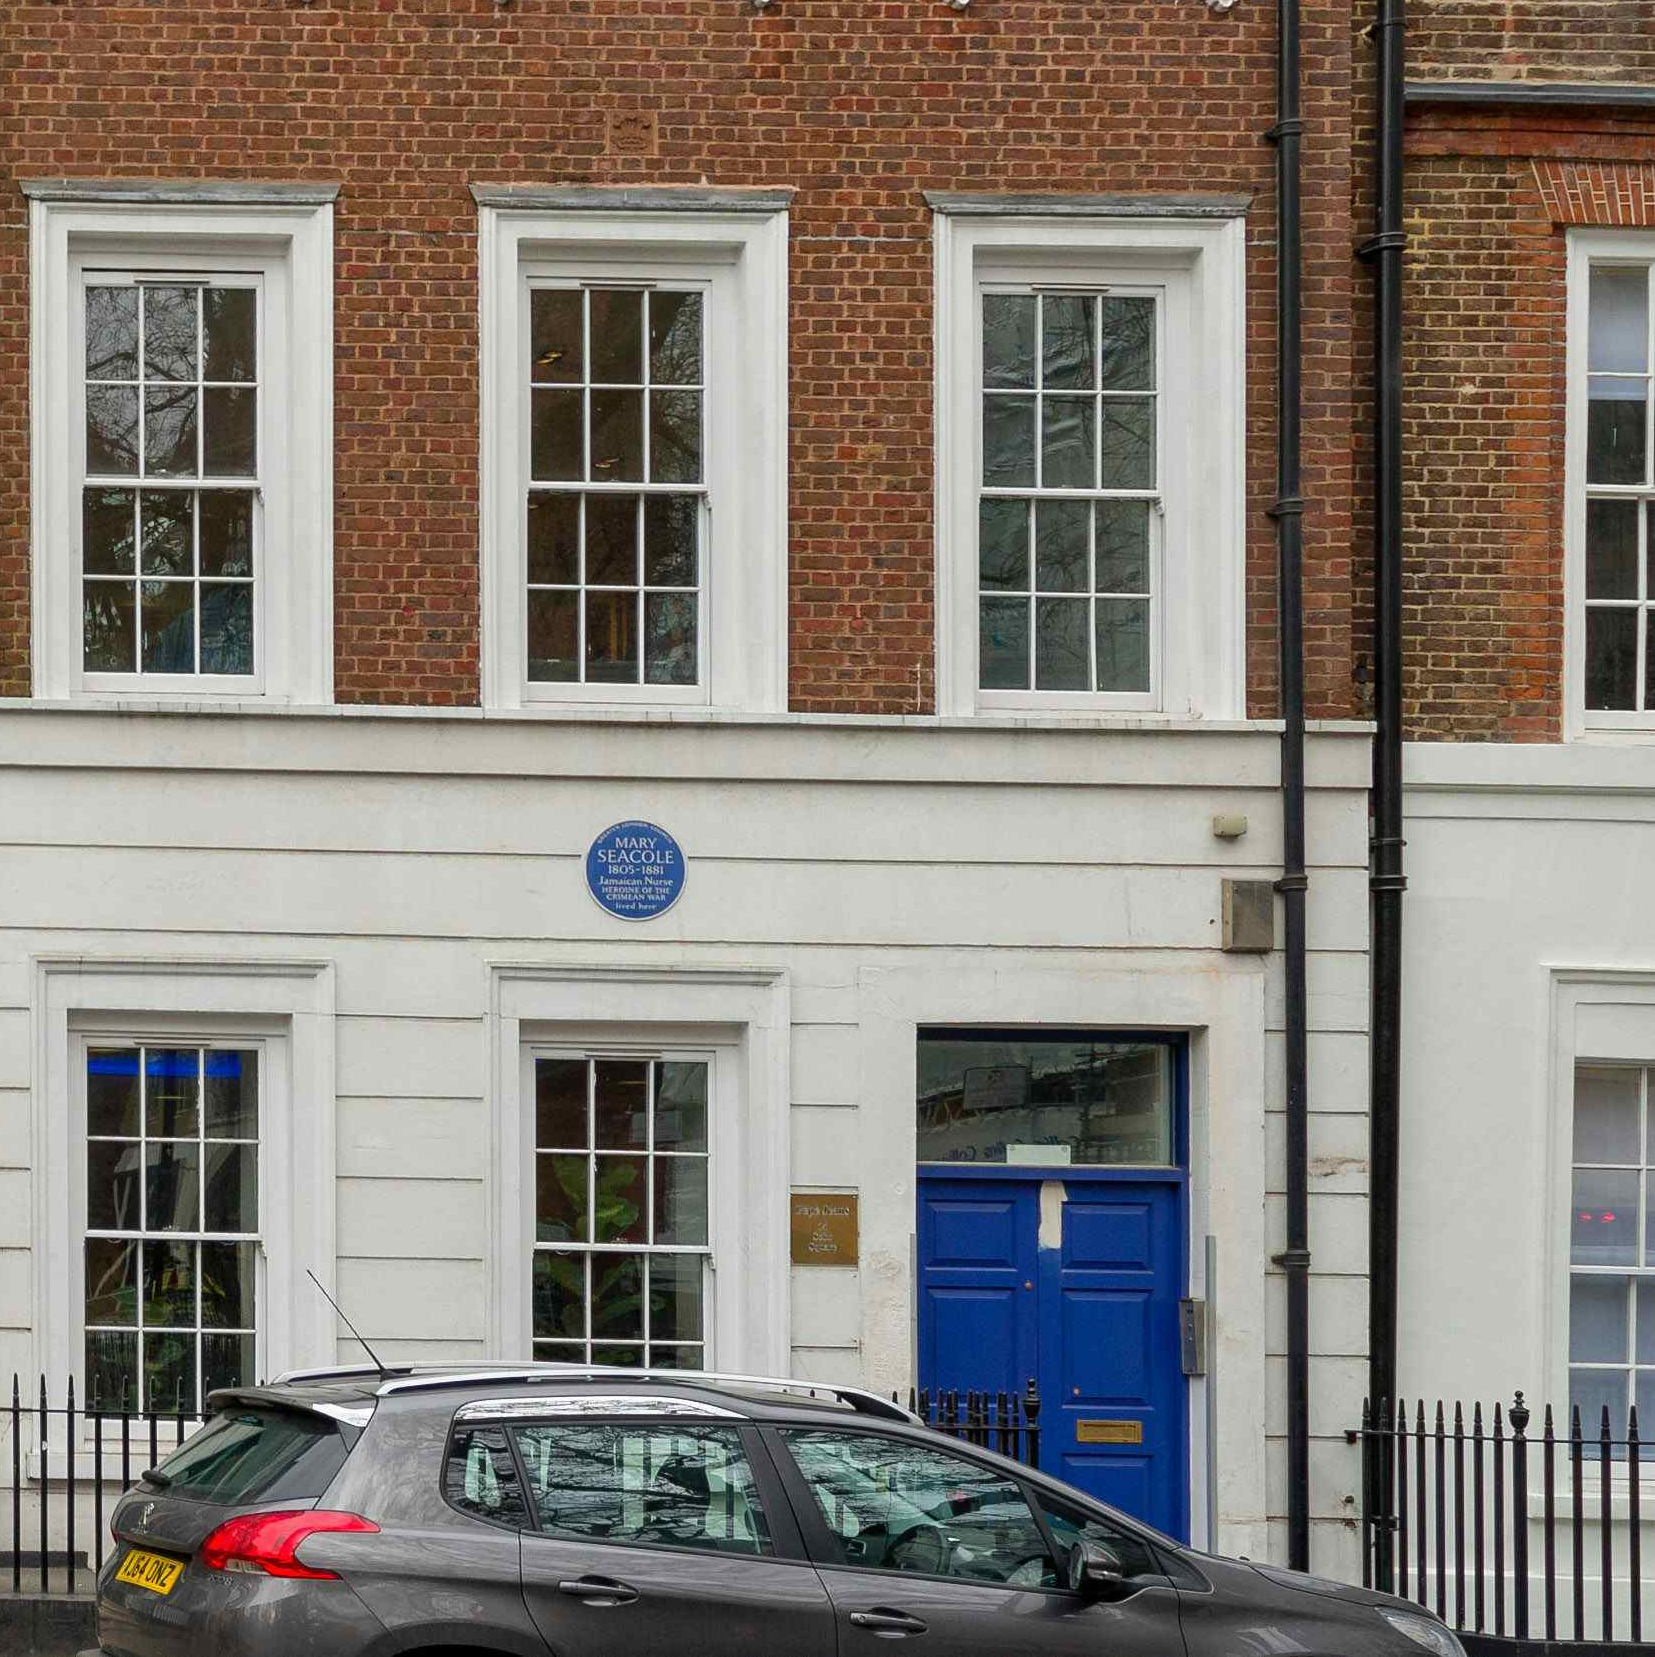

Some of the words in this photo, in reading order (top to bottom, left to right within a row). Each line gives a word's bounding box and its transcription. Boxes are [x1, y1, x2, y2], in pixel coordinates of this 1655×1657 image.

[615, 837, 657, 849] MARY
[597, 849, 674, 864] SEACOLE
[608, 864, 664, 875] 1805-1881
[599, 875, 642, 886] Jamaican
[644, 876, 674, 886] Nurse
[146, 1559, 176, 1587] ONZ
